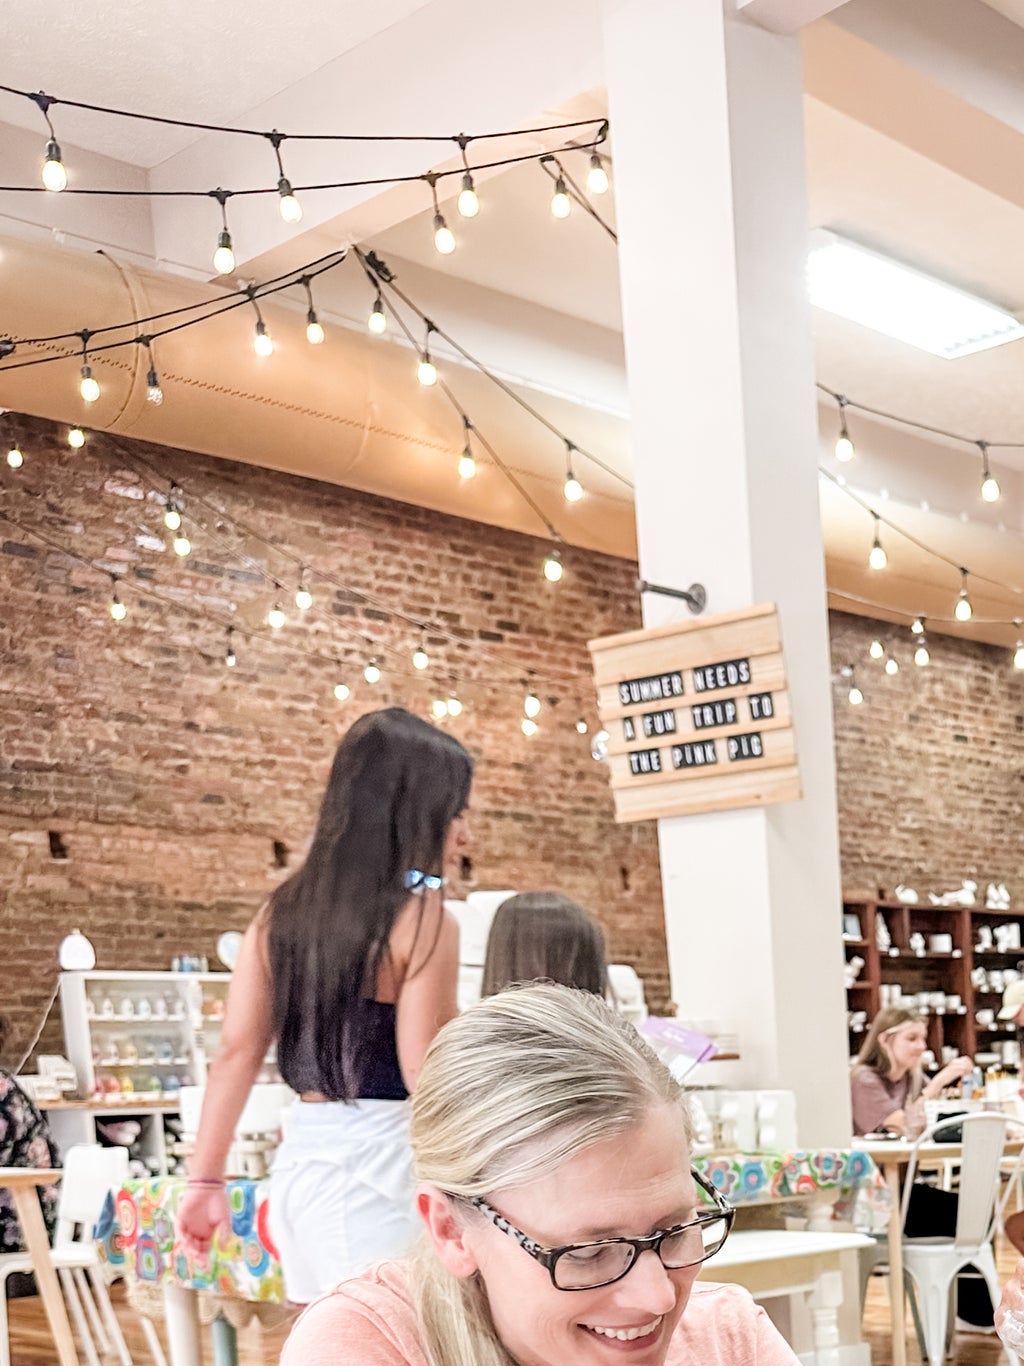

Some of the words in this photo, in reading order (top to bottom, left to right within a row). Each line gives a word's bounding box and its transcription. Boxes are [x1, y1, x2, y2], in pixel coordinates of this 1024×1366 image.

[619, 673, 684, 705] SUMMER
[693, 660, 751, 692] NEEDS
[623, 718, 636, 741] A
[642, 711, 676, 738] FUN
[692, 701, 737, 729] TRIP
[750, 694, 773, 719] TO
[629, 750, 661, 775] THE
